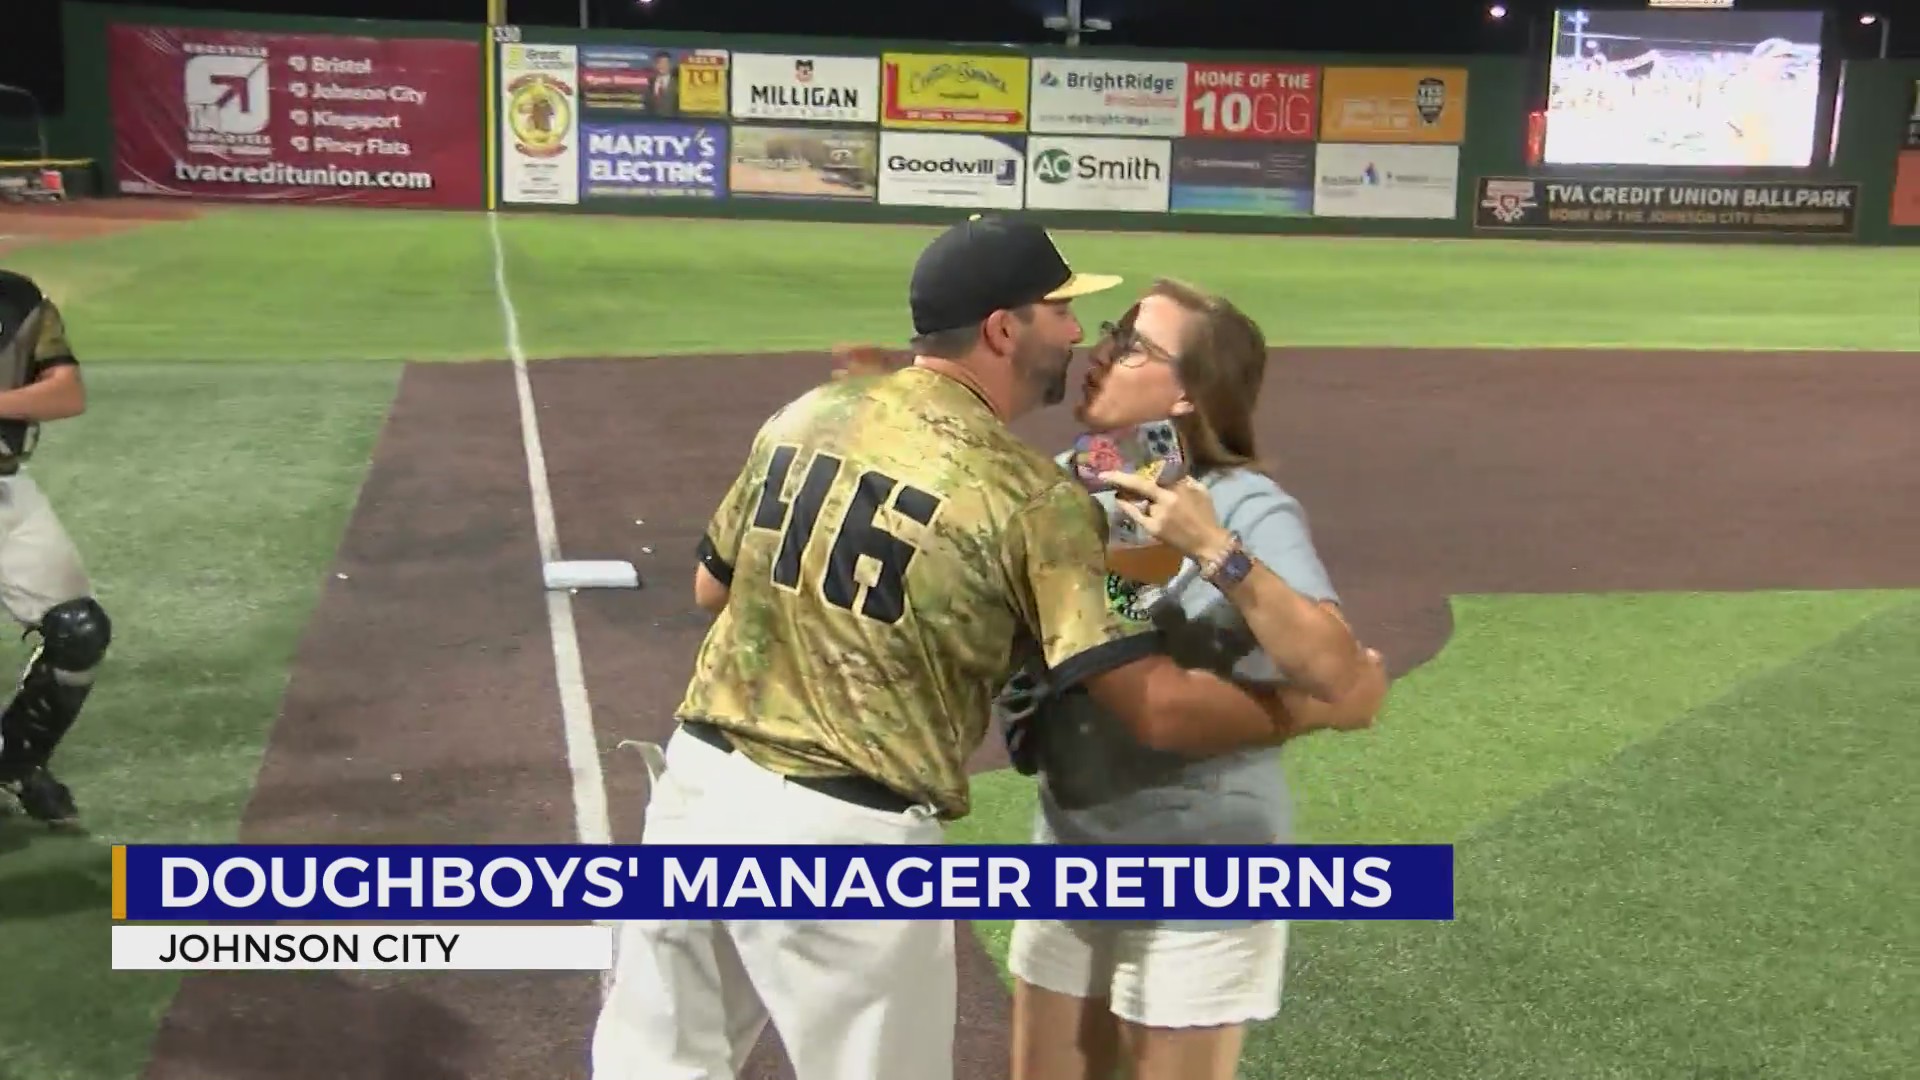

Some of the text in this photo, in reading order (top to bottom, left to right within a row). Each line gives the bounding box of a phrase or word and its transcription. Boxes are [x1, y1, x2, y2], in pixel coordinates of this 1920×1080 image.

[311, 56, 371, 73] Bristol
[1066, 72, 1175, 94] BrightRidge
[1194, 70, 1312, 89] HOME OF THE
[312, 83, 427, 105] Johnson City
[750, 84, 859, 108] MILLIGAN
[176, 161, 432, 189] tvacreditunion.com
[589, 160, 716, 182] ELECTRIC
[887, 155, 993, 175] Goodwill
[1077, 155, 1161, 181] Smith
[1545, 184, 1852, 208] TVA CREDIT UNION BALLPARK
[752, 444, 943, 626] 46
